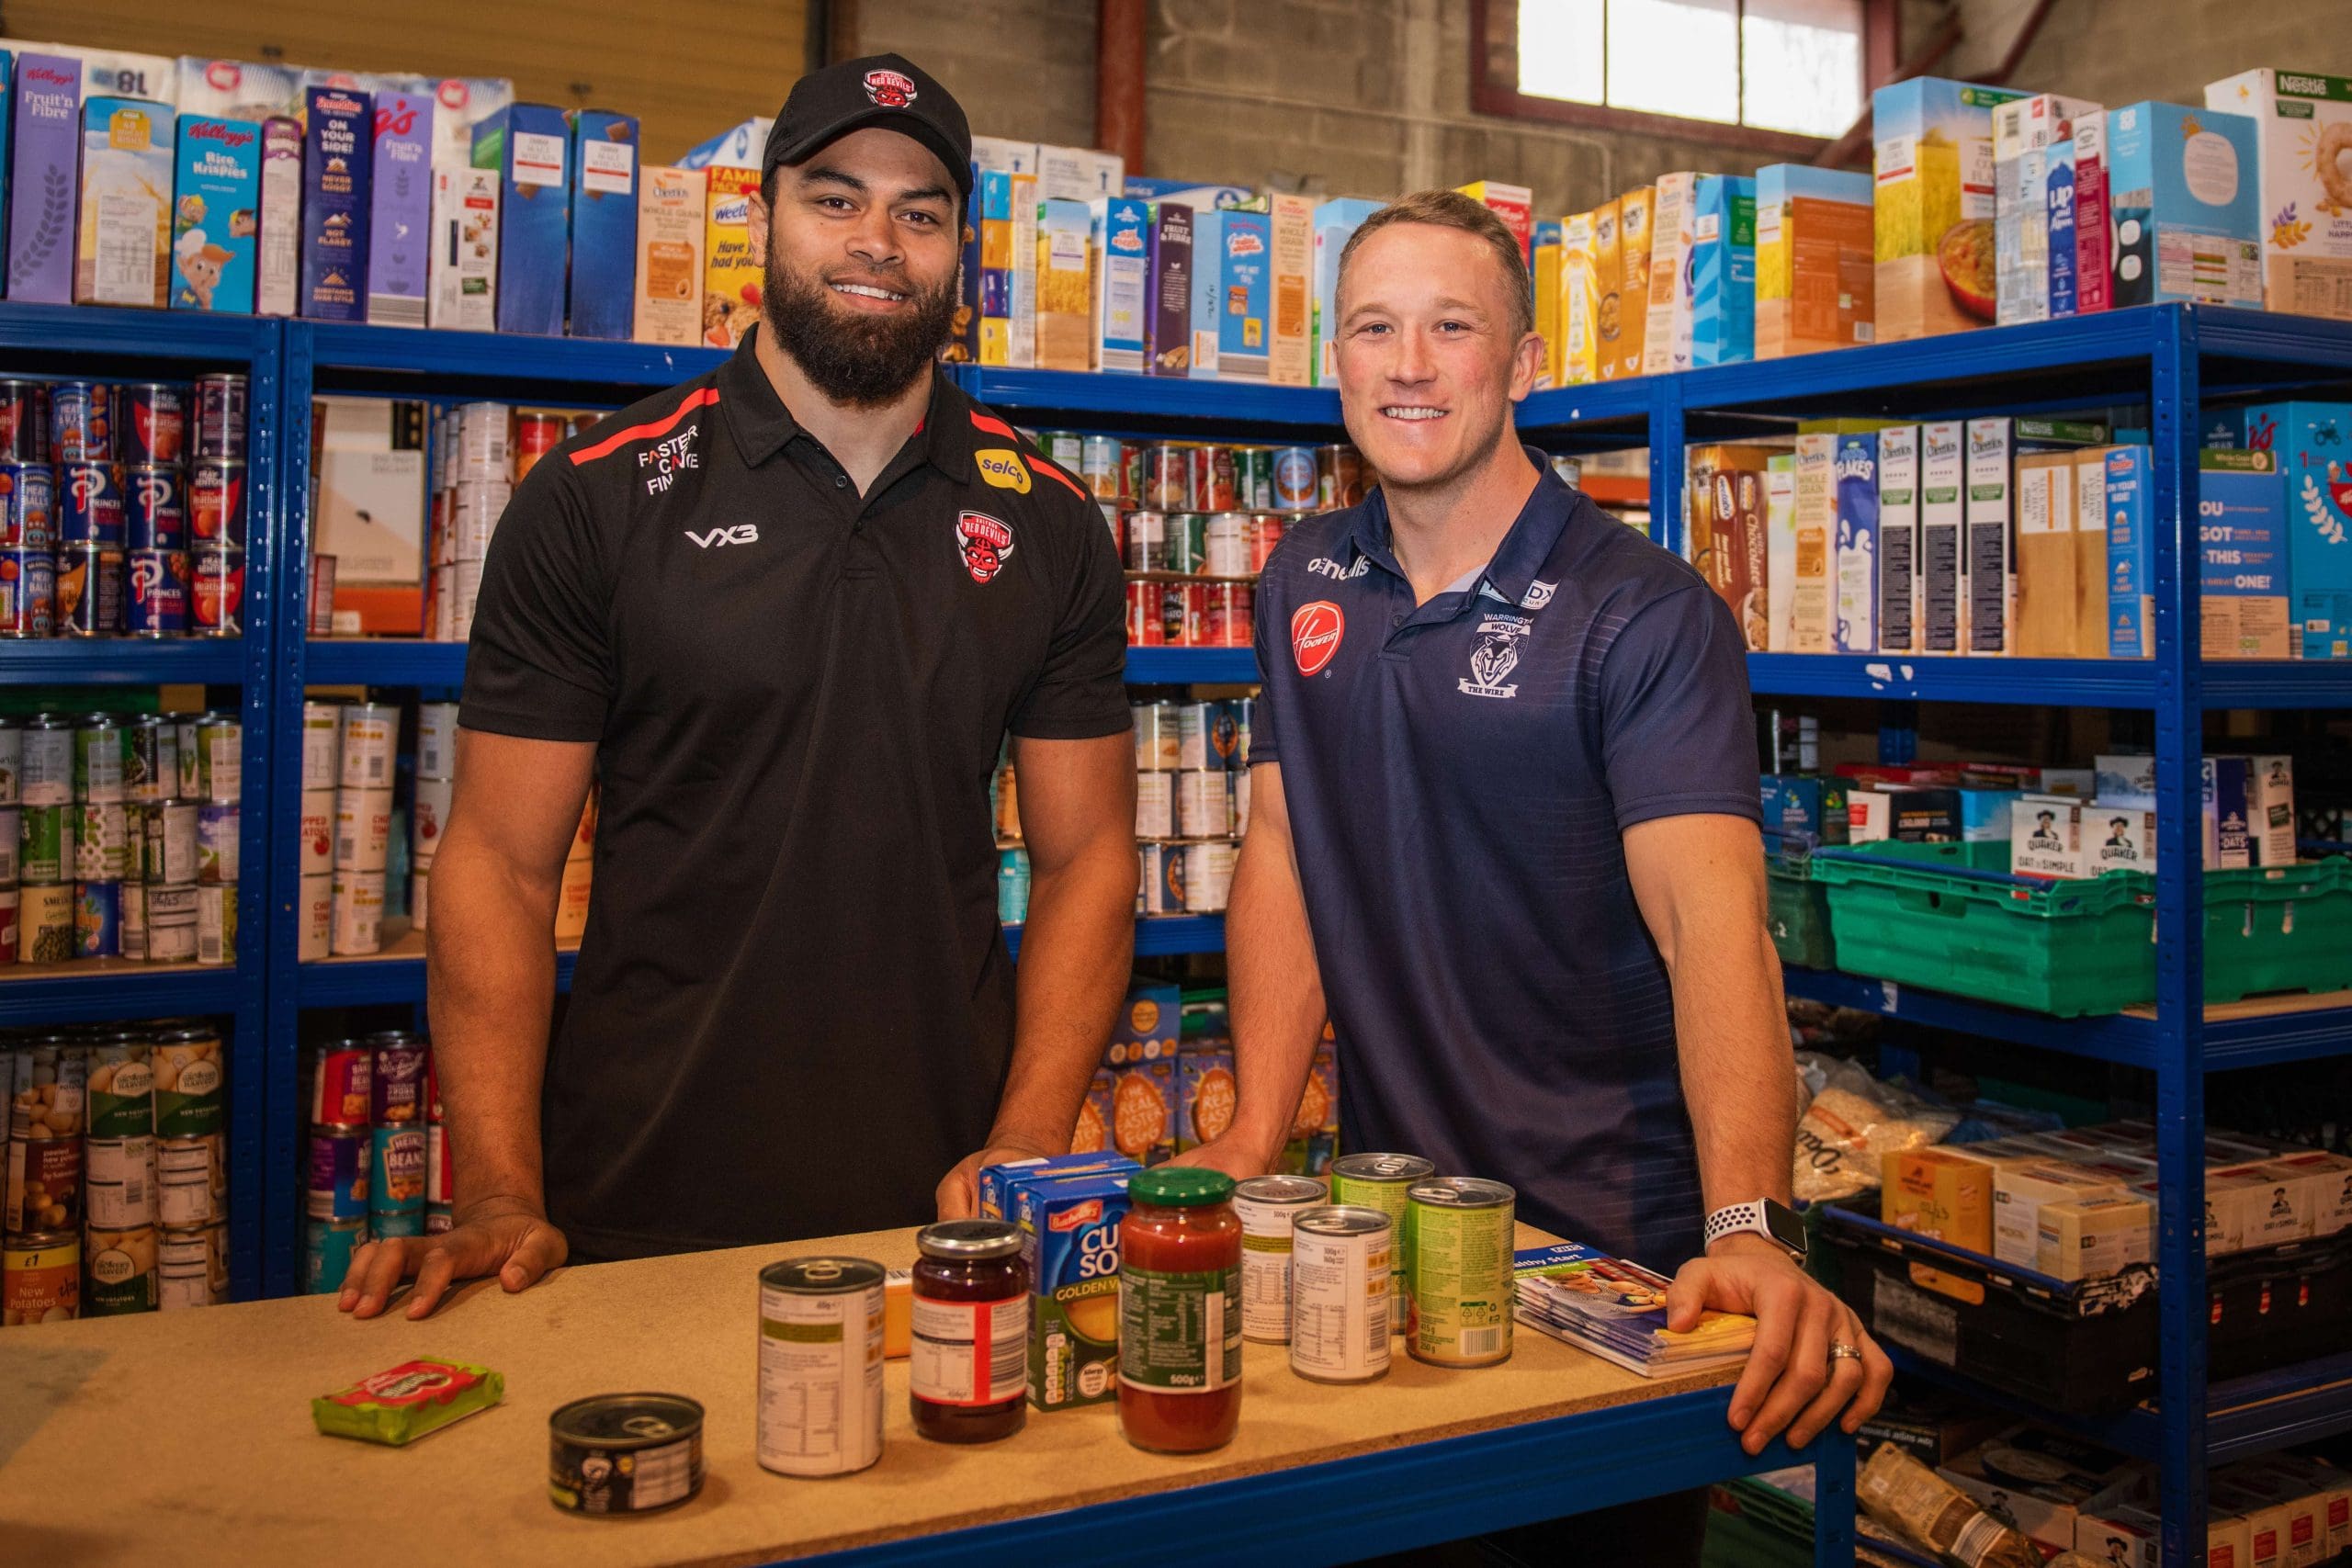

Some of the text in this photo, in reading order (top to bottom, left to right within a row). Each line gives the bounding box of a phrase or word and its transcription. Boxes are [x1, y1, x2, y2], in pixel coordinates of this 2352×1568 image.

[26, 67, 74, 85] Kellogg's
[872, 77, 912, 91] RED DEVILS
[25, 90, 74, 108] Fruit'n
[31, 103, 69, 119] Fibre
[328, 119, 348, 130] ON
[188, 120, 254, 147] Kellogg's
[321, 130, 356, 142] YOUR
[322, 141, 355, 154] SIDE!
[205, 152, 235, 166] Rice
[193, 162, 247, 179] Krispies
[712, 181, 741, 194] PACK
[2050, 185, 2074, 209] UP
[1163, 224, 1190, 234] FRUIT
[1168, 233, 1192, 244] FIBRE
[718, 240, 745, 254] Have
[711, 255, 754, 271] had you
[638, 424, 699, 468] FASTER
[981, 457, 1023, 484] selco
[1837, 460, 1874, 481] FLAKES
[1799, 484, 1825, 495] GRAIN
[2199, 501, 2223, 515] OU
[684, 524, 759, 548] VX3
[965, 521, 1008, 545] RED DEVILS
[1746, 513, 1761, 588] Chocolate
[2207, 550, 2242, 565] THIS
[2234, 575, 2271, 590] ONE!
[1484, 613, 1534, 626] WARRINGT
[1468, 685, 1505, 696] THE WIRE
[2028, 839, 2064, 854] QUAKER
[2101, 846, 2138, 862] QUAKER
[2018, 856, 2075, 874] OAT SIMPLE
[1204, 1079, 1228, 1093] THE
[1203, 1093, 1235, 1110] REA
[1080, 1224, 1119, 1255] CU
[1551, 1244, 1583, 1254] NHS
[24, 1253, 39, 1268] £1
[1079, 1249, 1119, 1279] SO
[1514, 1253, 1583, 1268] althy Start
[18, 1286, 45, 1297] New
[1056, 1280, 1108, 1302] GOLDEN
[10, 1295, 56, 1308] Potatoes
